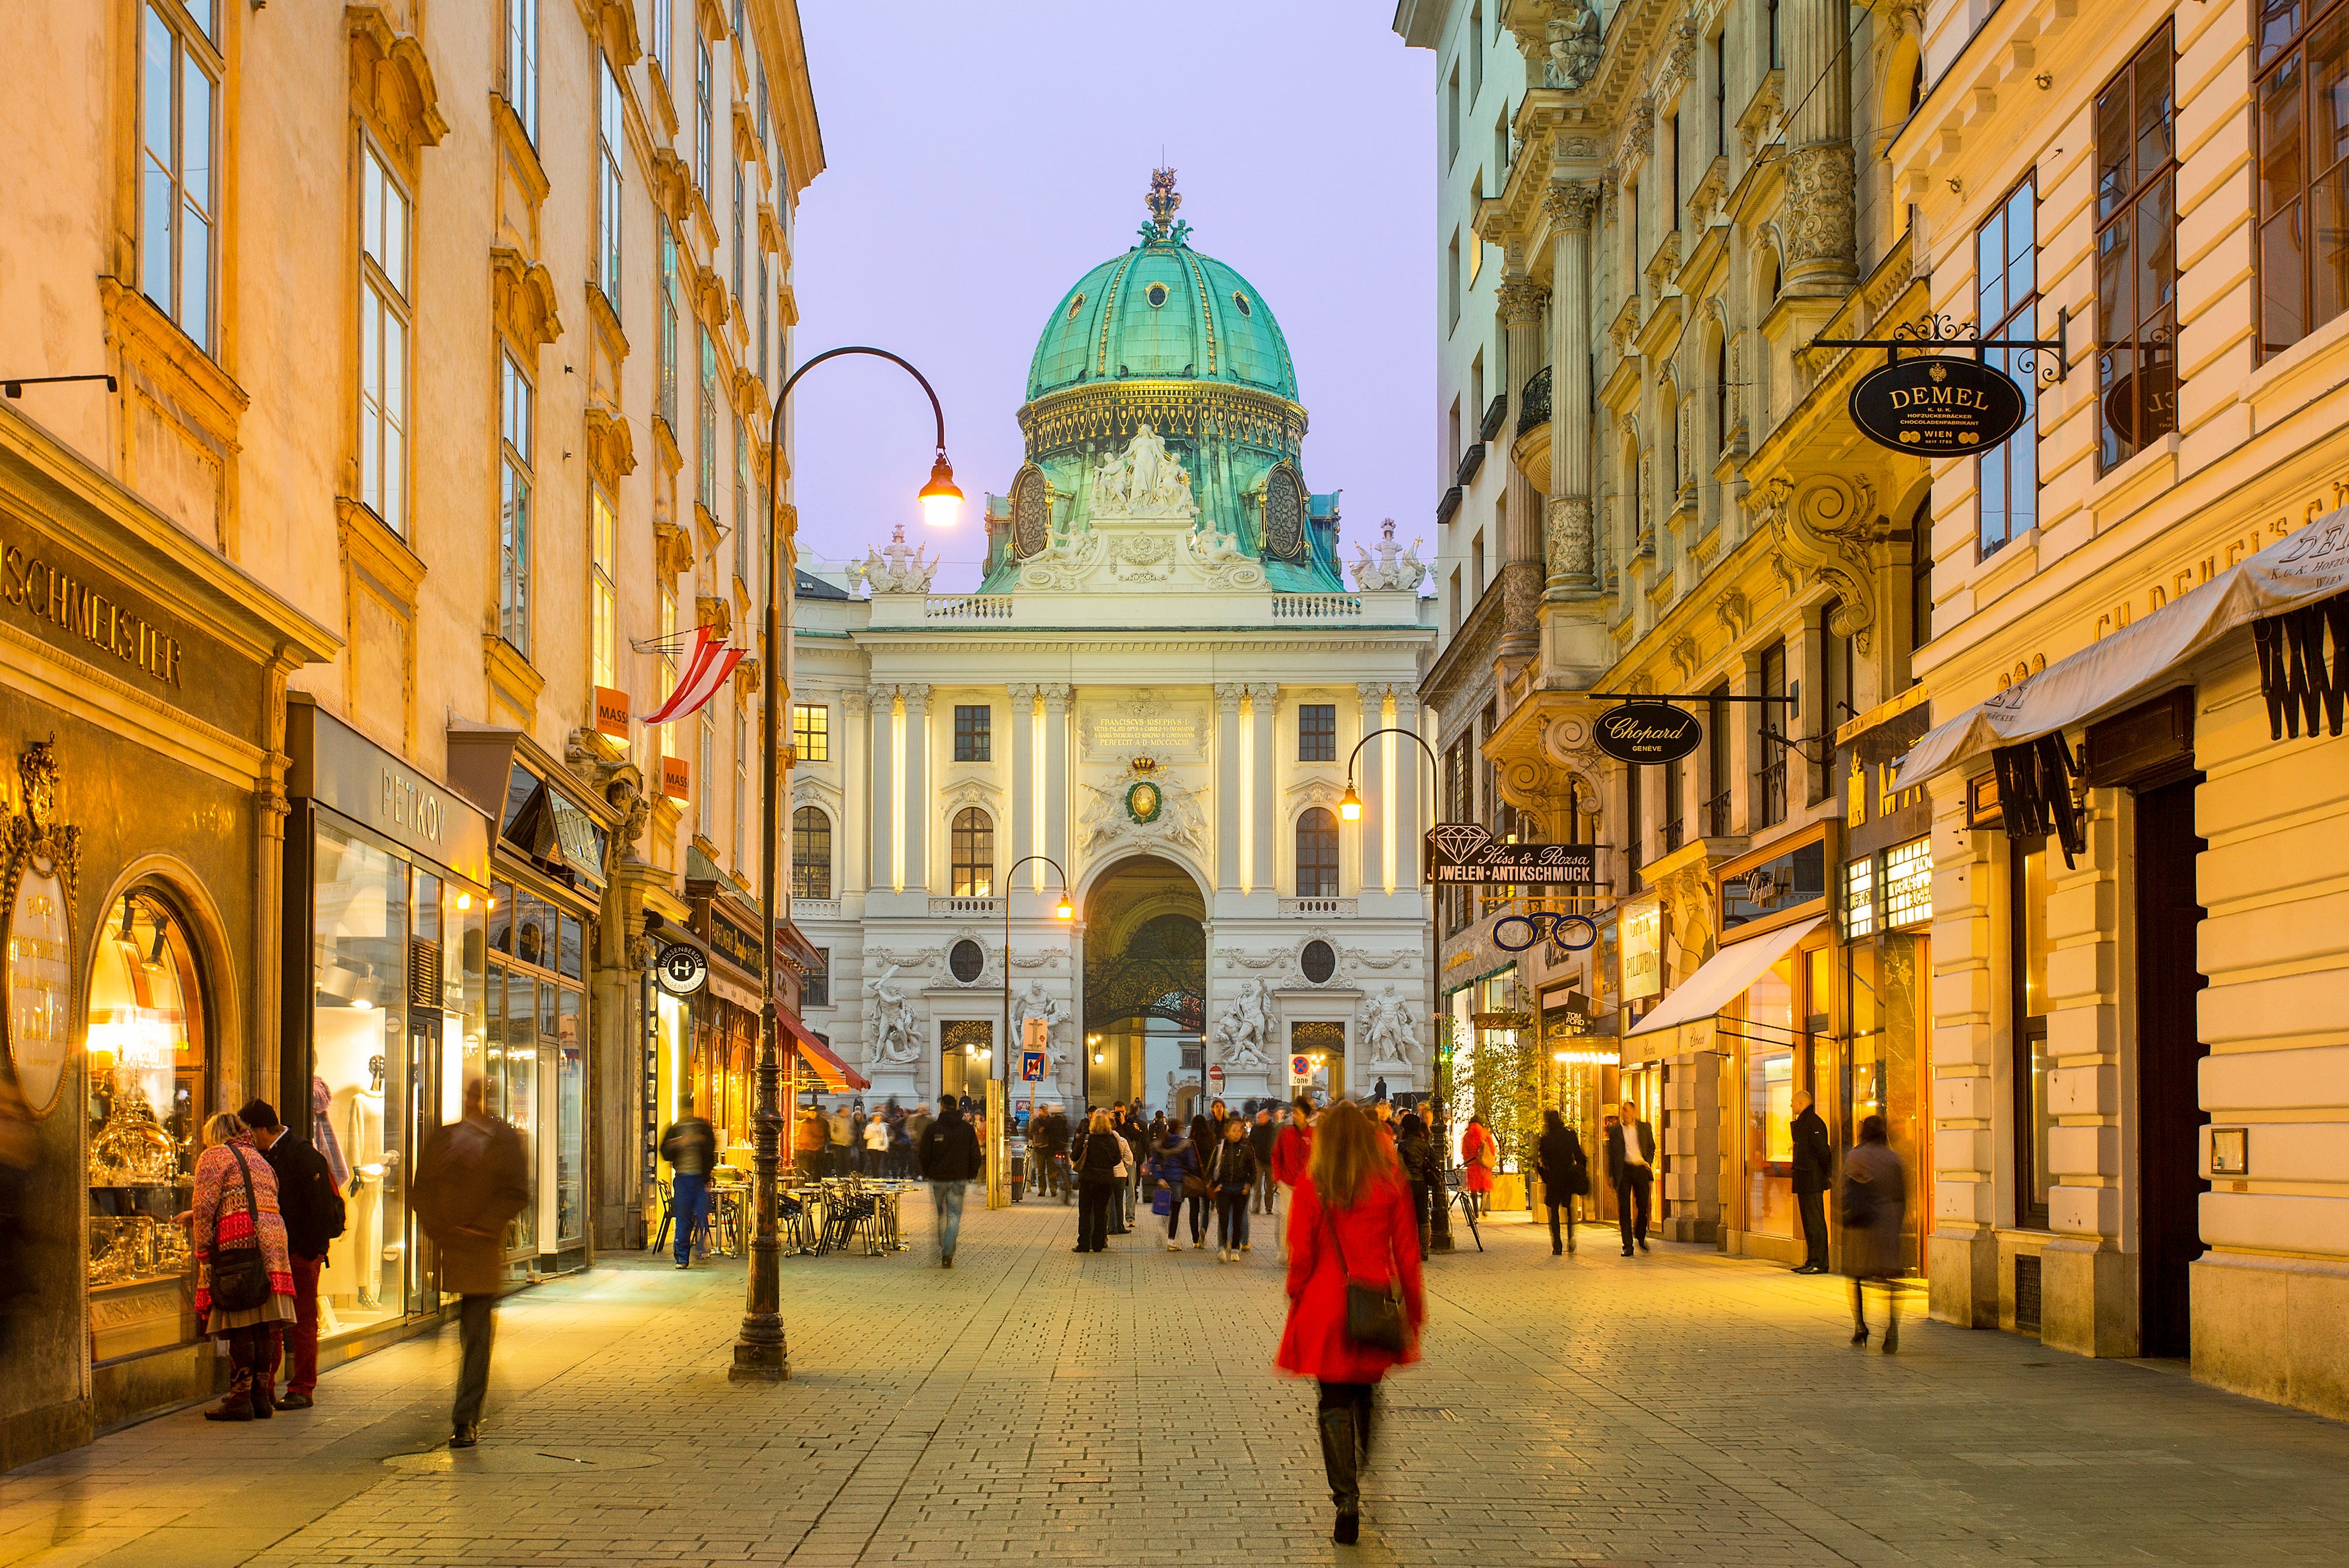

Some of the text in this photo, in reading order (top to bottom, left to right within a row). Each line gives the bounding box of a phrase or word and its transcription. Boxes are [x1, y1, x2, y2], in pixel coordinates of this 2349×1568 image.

[1889, 386, 1989, 411] DEMEL
[1605, 716, 1690, 744] Chopard
[666, 773, 689, 789] MASS
[382, 768, 445, 846] PETKOV
[1478, 845, 1590, 866] Kiss & Rozsa
[1491, 866, 1590, 881] ANTIKSCHMUCK
[1746, 866, 1776, 908] Chopard
[1630, 910, 1651, 937] OPTIK
[661, 947, 704, 967] HEISSENBERGER
[1627, 949, 1657, 979] PILLWEIN
[661, 970, 704, 990] HEISSENBERGER
[1488, 1018, 1505, 1028] Loro
[1566, 1018, 1584, 1027] FORD
[1567, 1011, 1581, 1019] TOM
